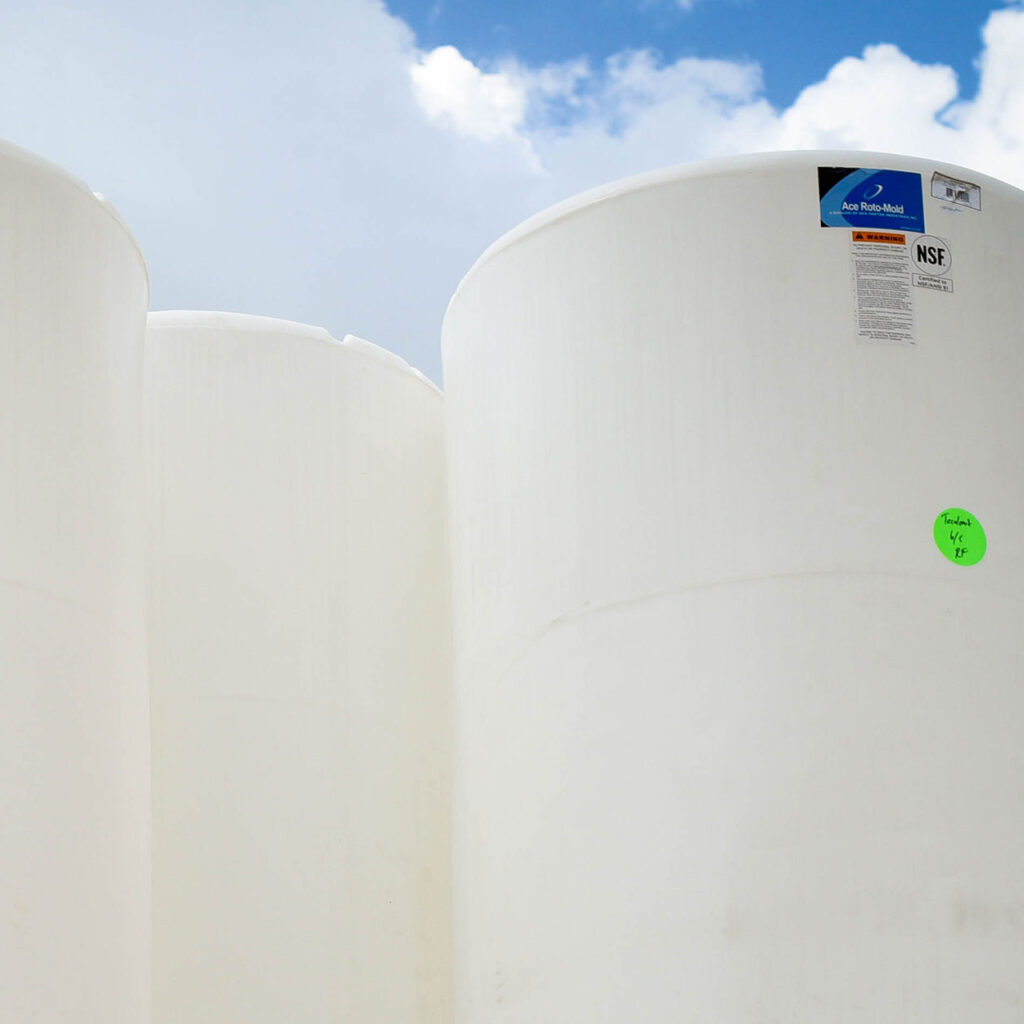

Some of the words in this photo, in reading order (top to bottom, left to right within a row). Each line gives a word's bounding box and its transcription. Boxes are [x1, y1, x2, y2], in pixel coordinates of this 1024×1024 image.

[842, 202, 859, 211] Ace
[860, 202, 904, 214] Roto-Mold
[867, 234, 904, 242] WARNING
[917, 244, 945, 266] NSF
